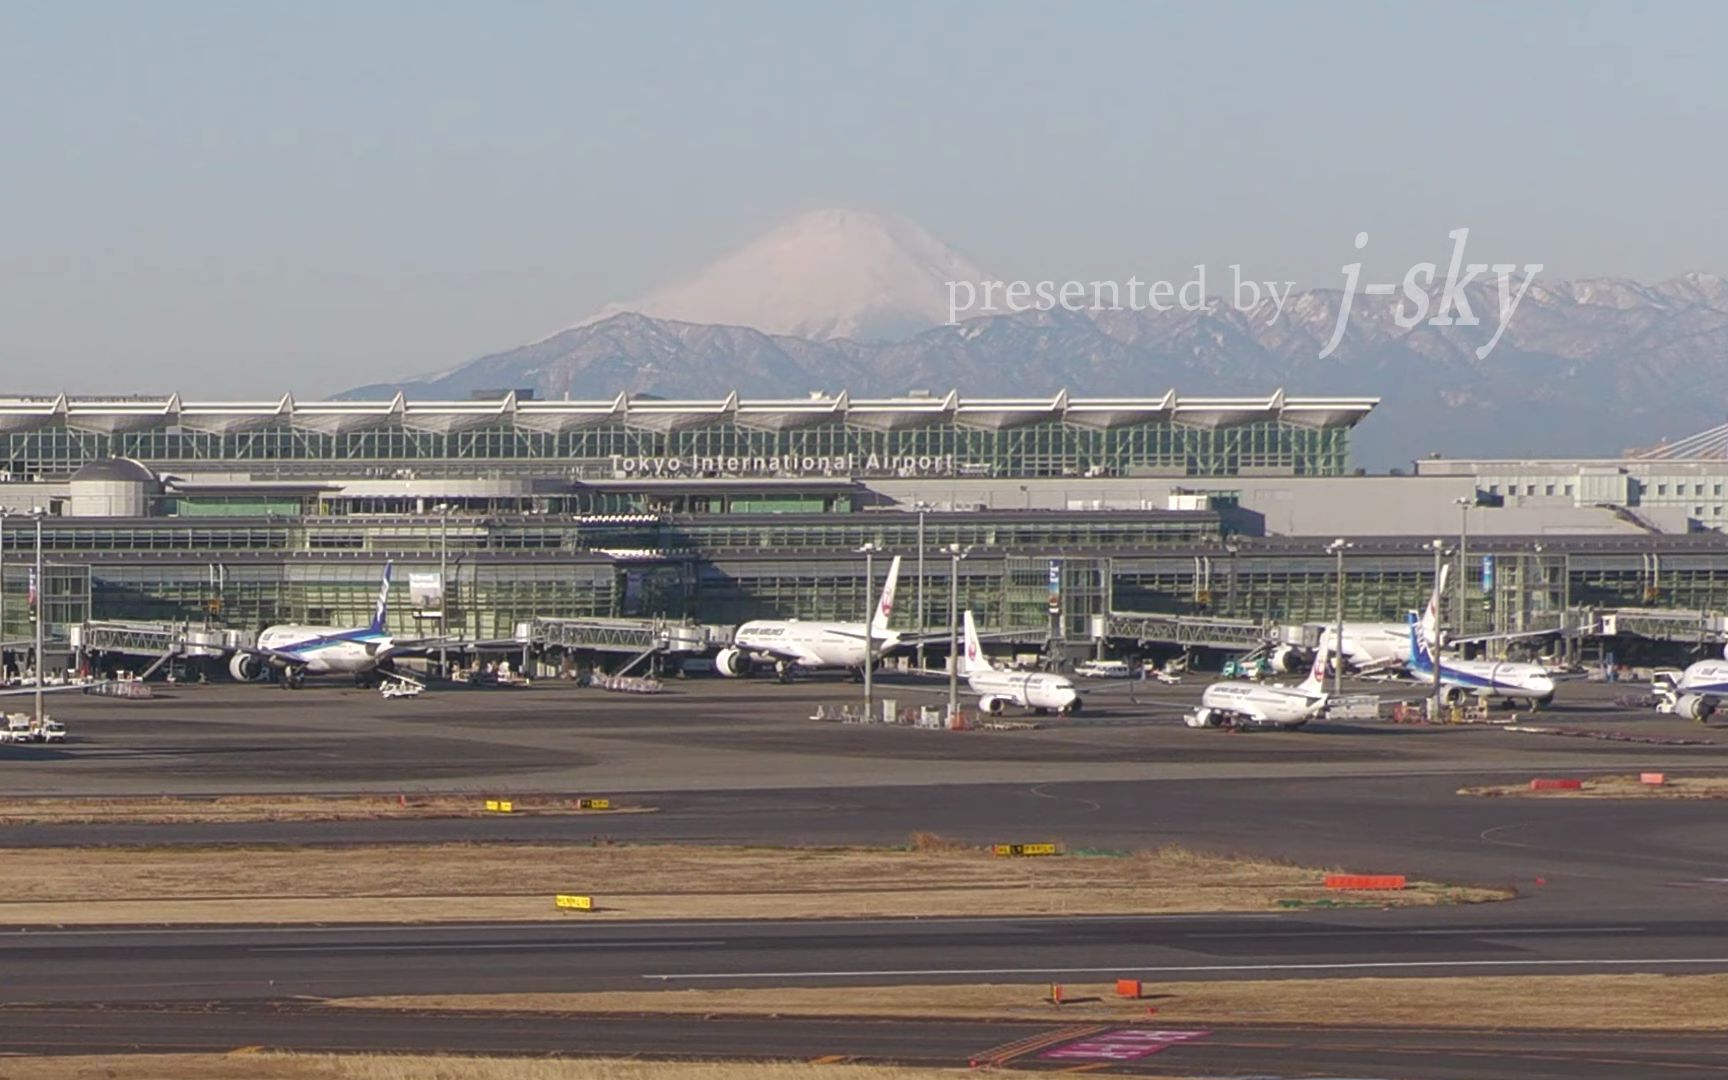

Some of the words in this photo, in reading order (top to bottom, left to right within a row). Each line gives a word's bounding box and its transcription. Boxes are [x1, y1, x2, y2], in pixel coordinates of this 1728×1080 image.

[610, 453, 680, 475] Tokyo
[693, 453, 852, 471] International
[866, 453, 954, 474] Airport
